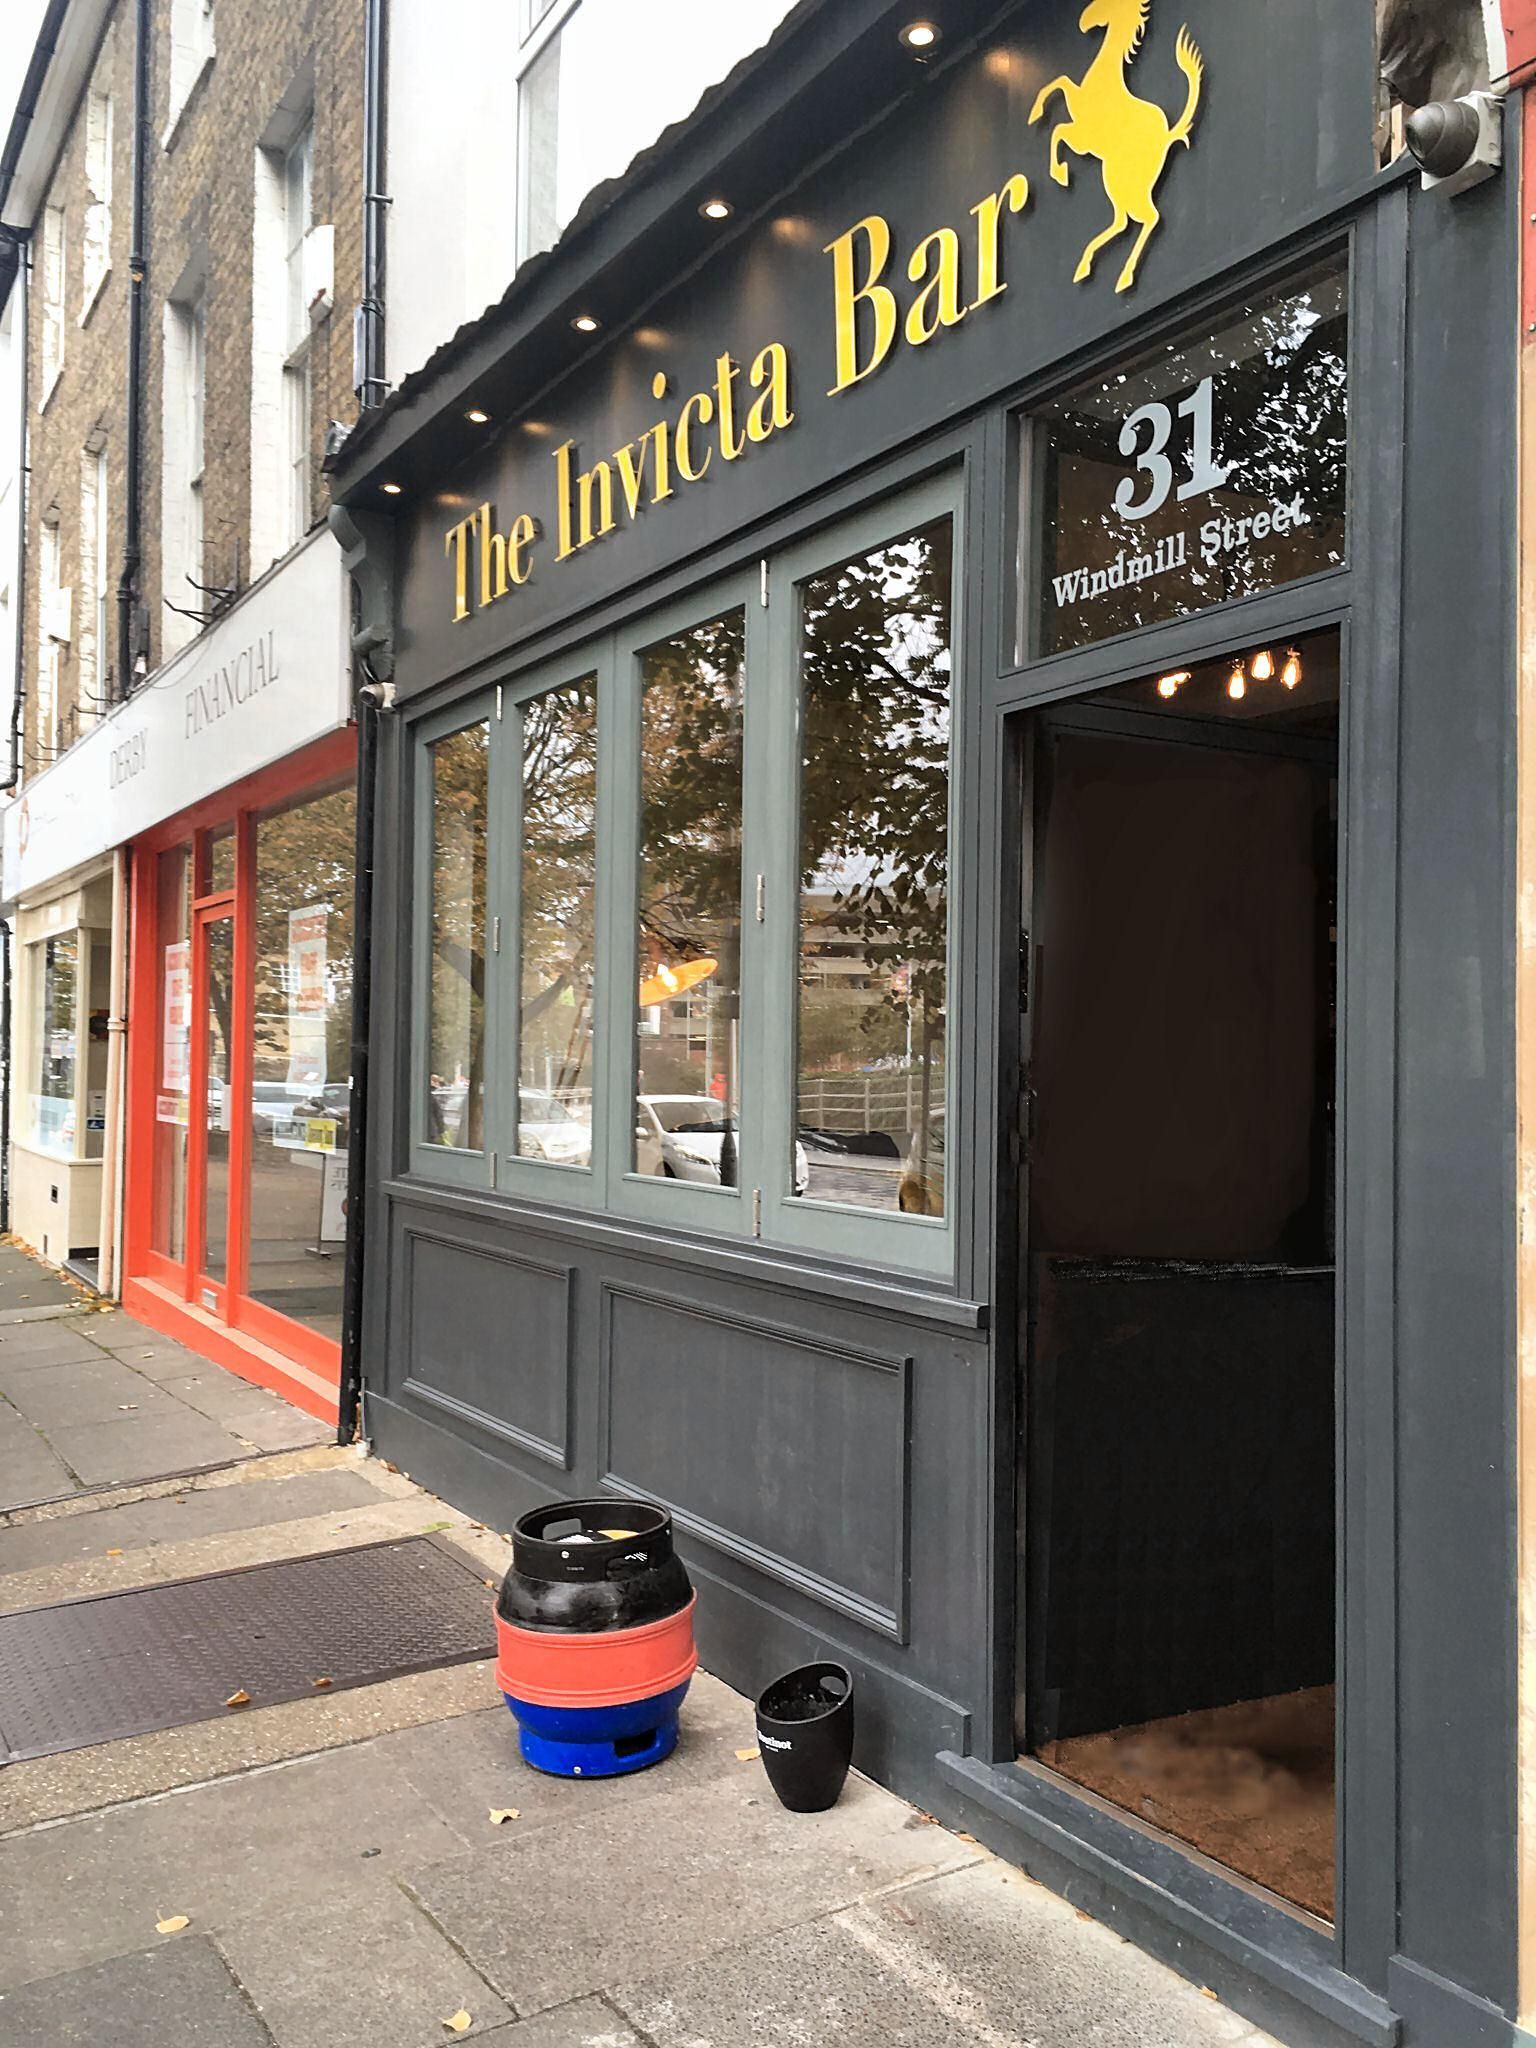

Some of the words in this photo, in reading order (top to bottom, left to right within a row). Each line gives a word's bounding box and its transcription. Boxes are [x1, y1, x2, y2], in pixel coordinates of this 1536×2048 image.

[444, 502, 536, 622] The
[552, 342, 795, 562] Invicta
[822, 173, 1029, 397] Bar
[1115, 376, 1228, 521] 31
[1052, 532, 1187, 607] Windmill
[1200, 491, 1306, 559] Street
[109, 728, 149, 790] DERBY
[185, 629, 281, 740] FINANCIAL
